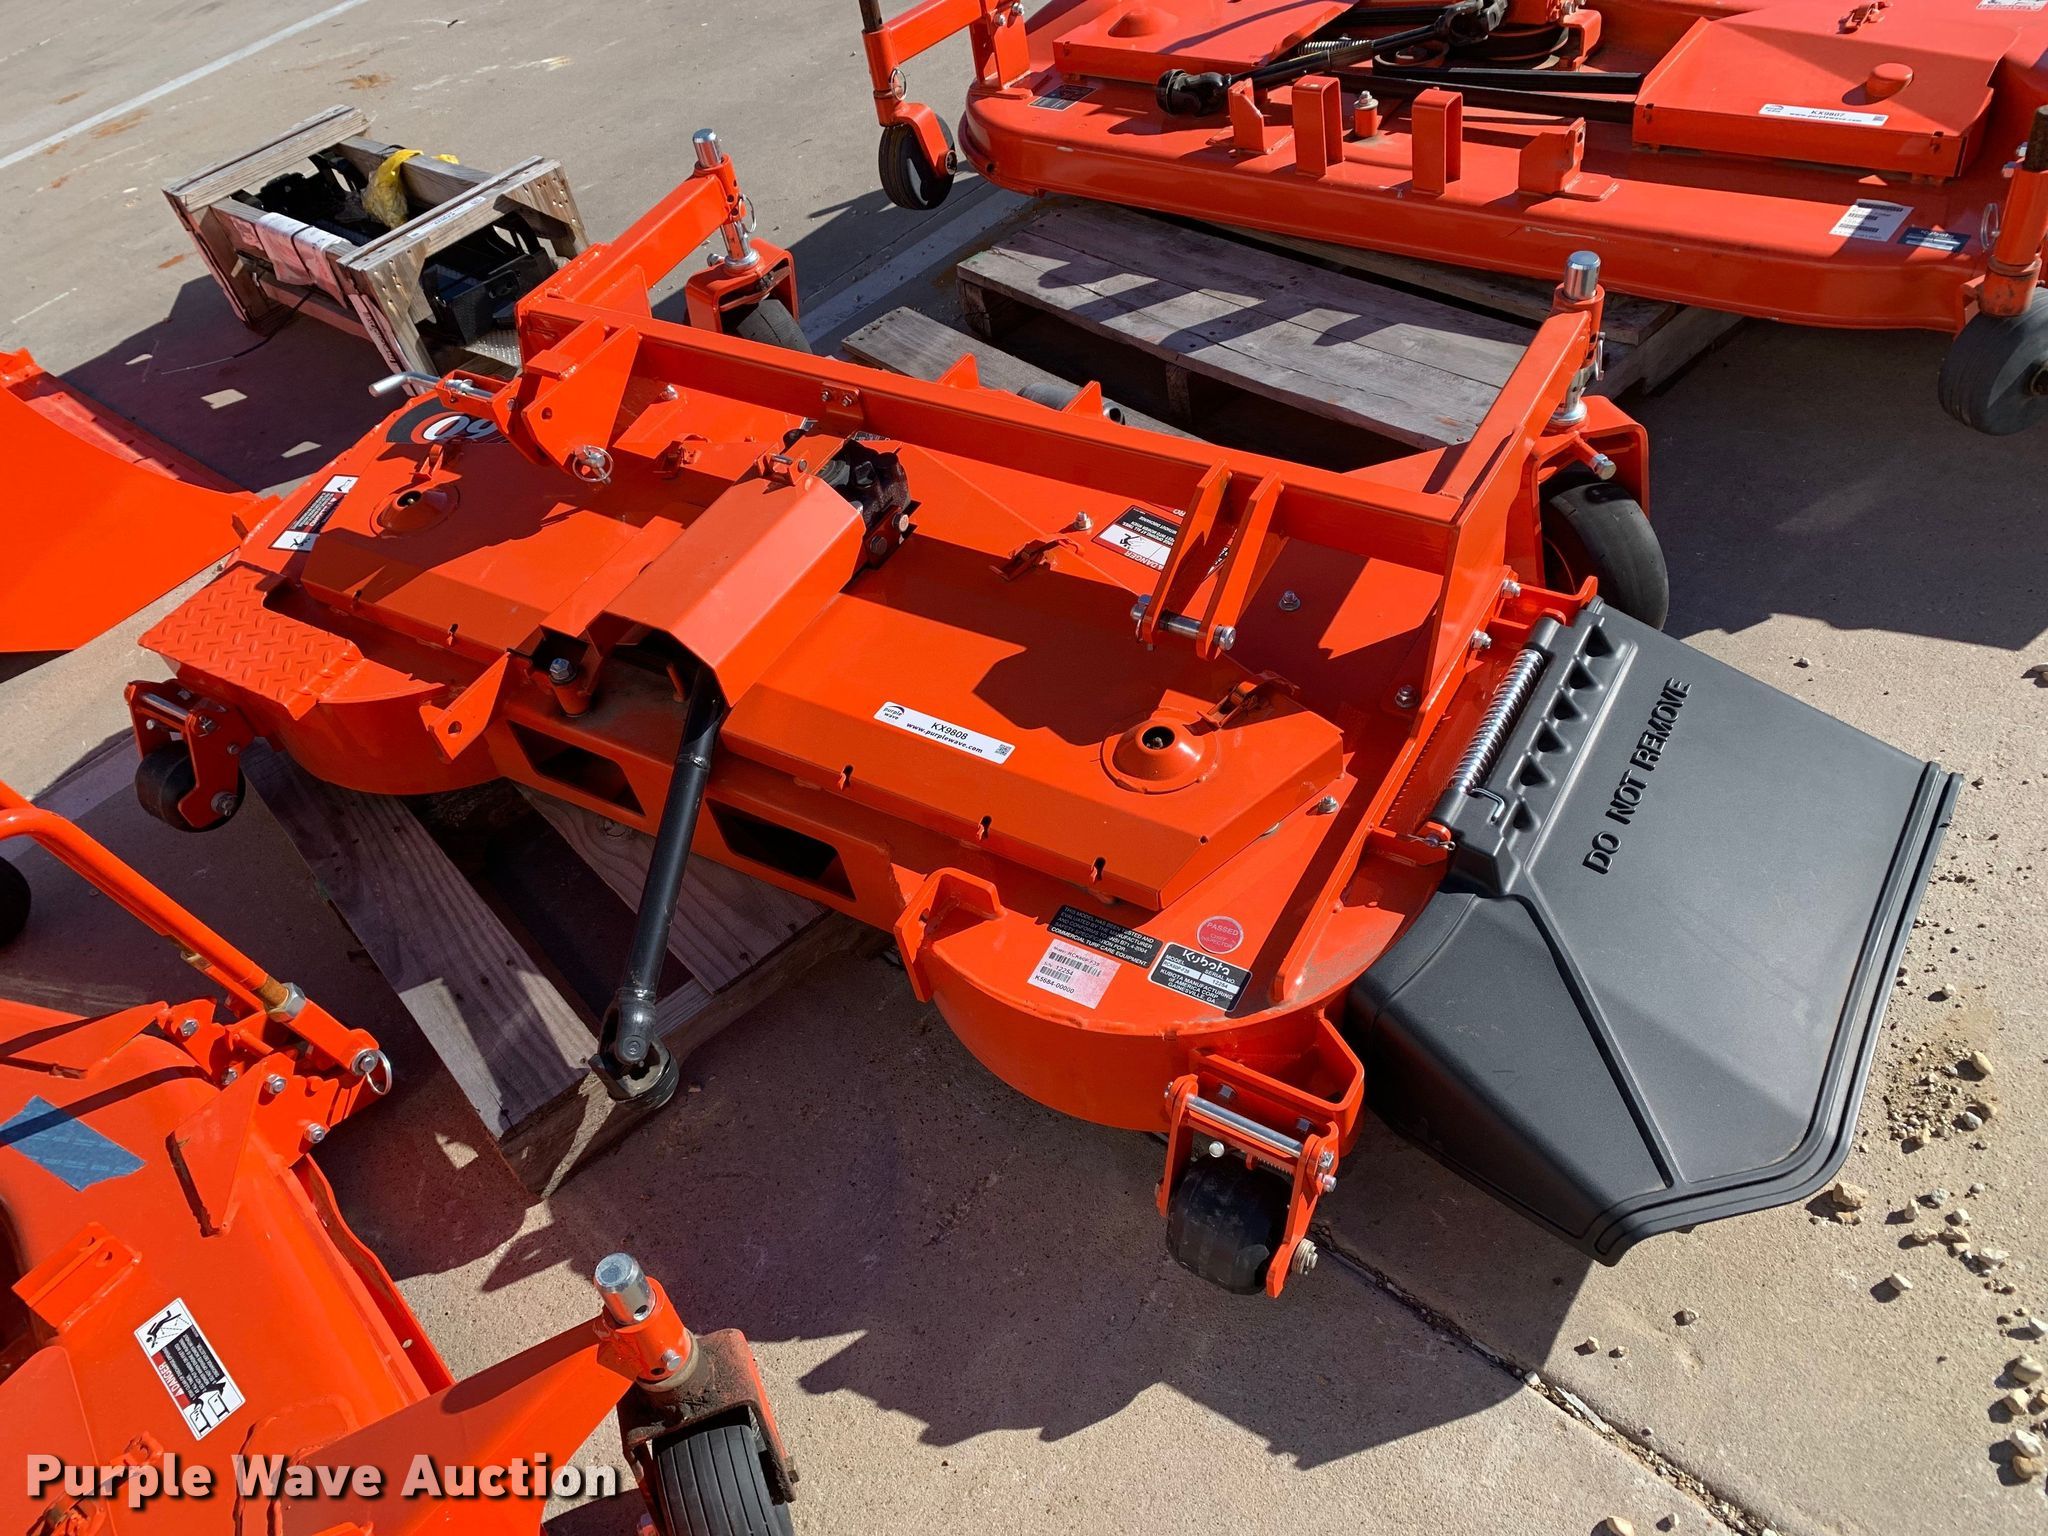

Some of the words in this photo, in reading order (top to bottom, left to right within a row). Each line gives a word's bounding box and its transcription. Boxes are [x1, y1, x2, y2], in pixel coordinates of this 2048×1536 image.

[1811, 110, 1846, 118] KX9807
[1124, 550, 1158, 568] DANGER
[906, 722, 984, 754] www.purplewave.com
[930, 721, 969, 740] KX9808
[1582, 830, 1622, 875] DO
[1605, 768, 1648, 825] NOT
[1629, 677, 1692, 771] REMOVE
[1120, 928, 1142, 938] TESTED
[1141, 935, 1154, 943] AND
[1206, 922, 1239, 936] PASSED
[1050, 926, 1085, 942] COMMERCIAL
[1085, 939, 1100, 948] TURF
[1099, 945, 1115, 953] CARE
[1114, 951, 1147, 965] EQUIPMENT
[1109, 929, 1153, 949] MANUFACTURER
[1113, 943, 1126, 951] FOR
[1164, 954, 1185, 965] MODEL
[1180, 949, 1232, 975] Kubota
[1054, 965, 1074, 975] 12254
[1204, 969, 1225, 980] SERIAL
[1159, 968, 1184, 981] KUBOTA
[1183, 977, 1234, 999] MANUFACTURING
[1174, 979, 1201, 992] AMERICA
[1211, 978, 1229, 988] 12254
[182, 1332, 193, 1347] WITHOUT
[161, 1346, 172, 1361] OPENING
[188, 1353, 197, 1365] ENGINE
[190, 1345, 200, 1358] MOWER
[169, 1358, 182, 1377] DISCHARGE
[185, 1361, 194, 1373] HANDS
[196, 1356, 207, 1371] OPERATE
[206, 1359, 219, 1377] DISCHARGE
[157, 1360, 180, 1392] DANGER
[199, 1372, 209, 1386] MOWER
[181, 1379, 190, 1391] CLEAR
